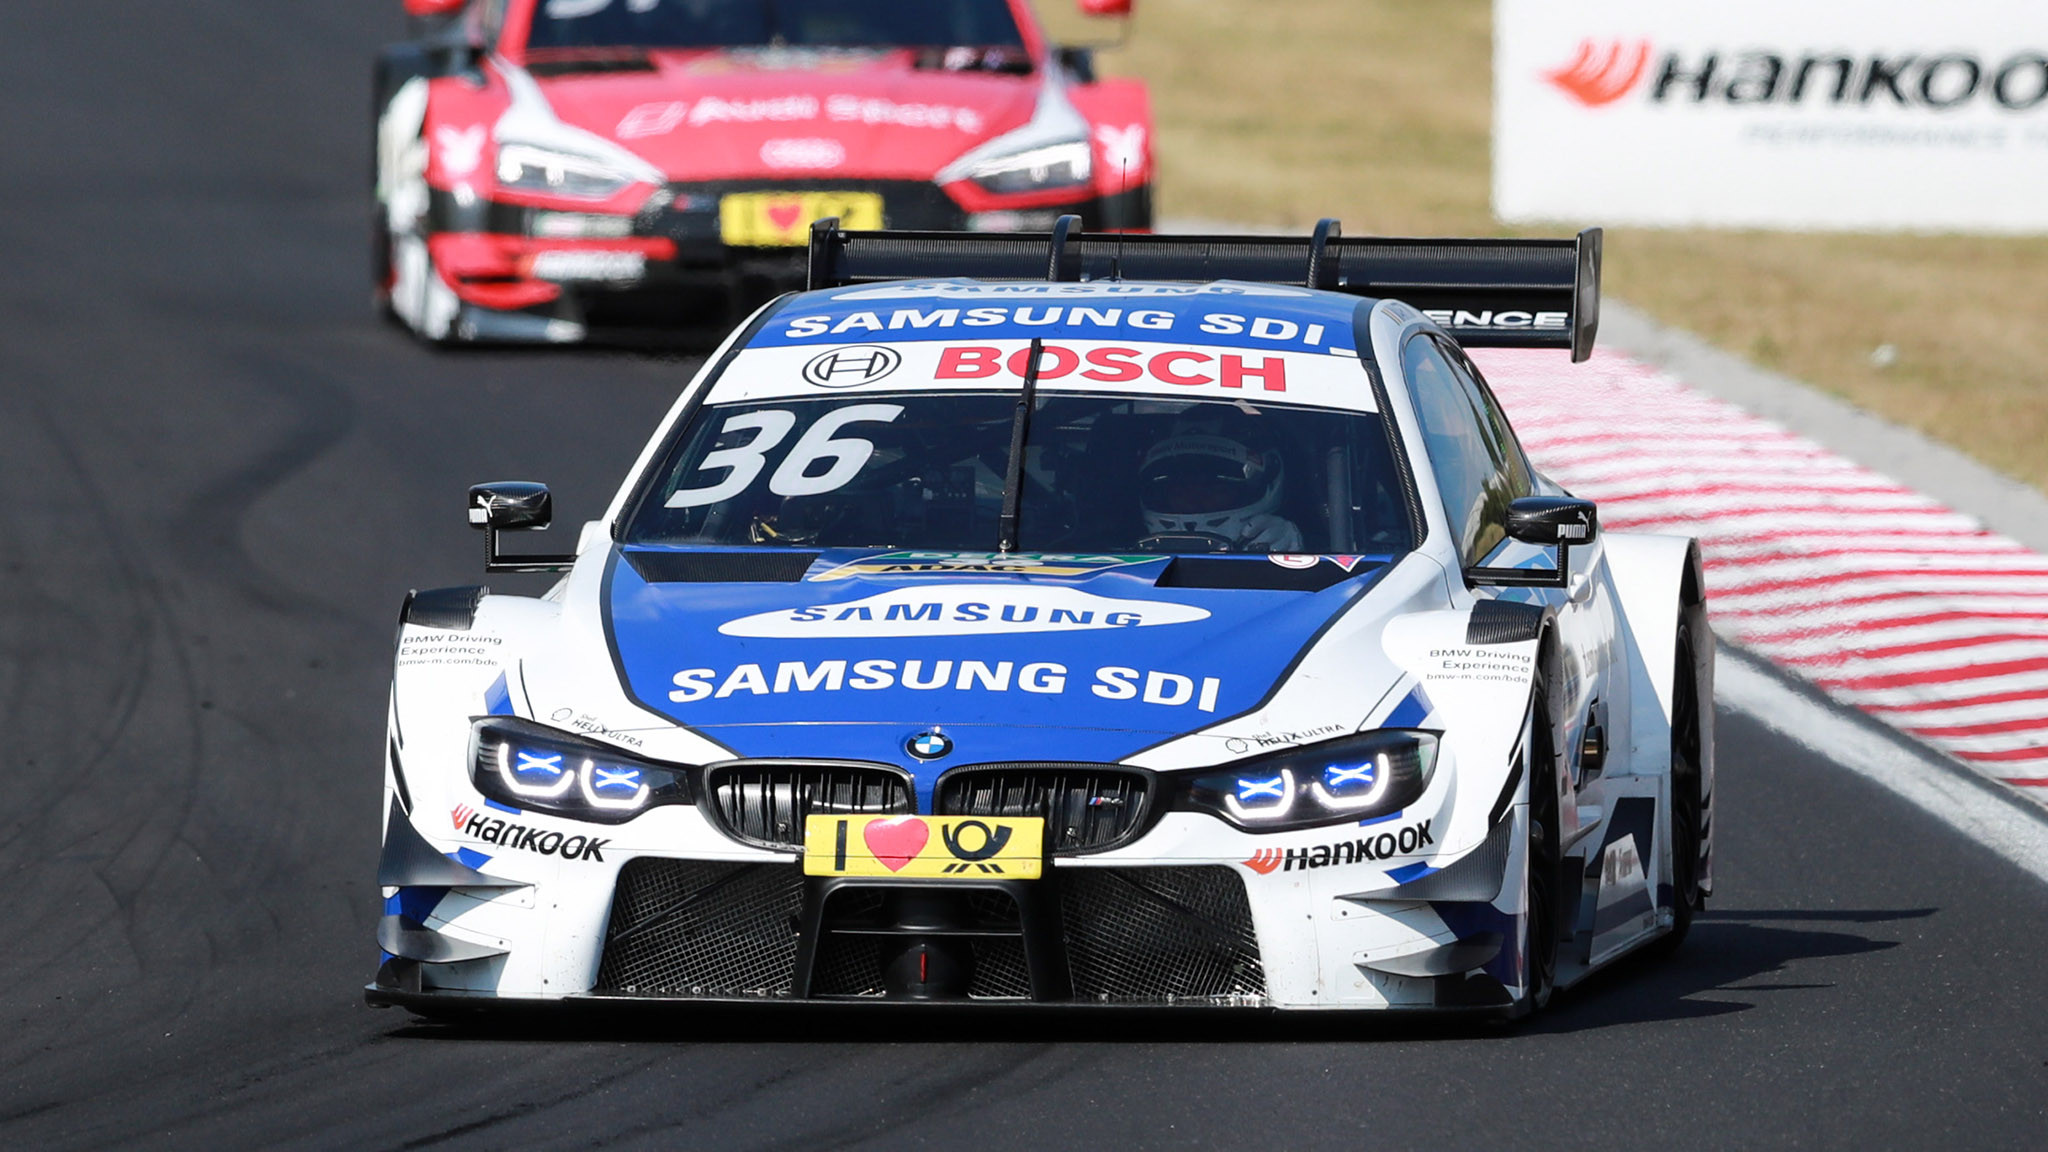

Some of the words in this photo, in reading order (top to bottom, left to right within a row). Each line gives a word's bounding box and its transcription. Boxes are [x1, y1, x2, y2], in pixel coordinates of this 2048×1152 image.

[899, 284, 1247, 295] SAMSUNG
[785, 306, 1176, 338] SAMSUNG
[1199, 313, 1327, 346] SDI
[934, 346, 1287, 392] BOSCH
[664, 404, 905, 508] 36
[1557, 523, 1586, 538] PUMA
[880, 565, 1026, 573] ADAC
[790, 602, 1142, 628] SAMSUNG
[403, 634, 445, 644] BMW
[448, 634, 502, 646] Driving
[401, 645, 485, 656] Experience
[1430, 649, 1471, 658] BMW
[1476, 650, 1531, 664] Driving
[1443, 660, 1529, 673] Experience
[669, 660, 1065, 704] SAMSUNG
[1091, 667, 1221, 713] SDI
